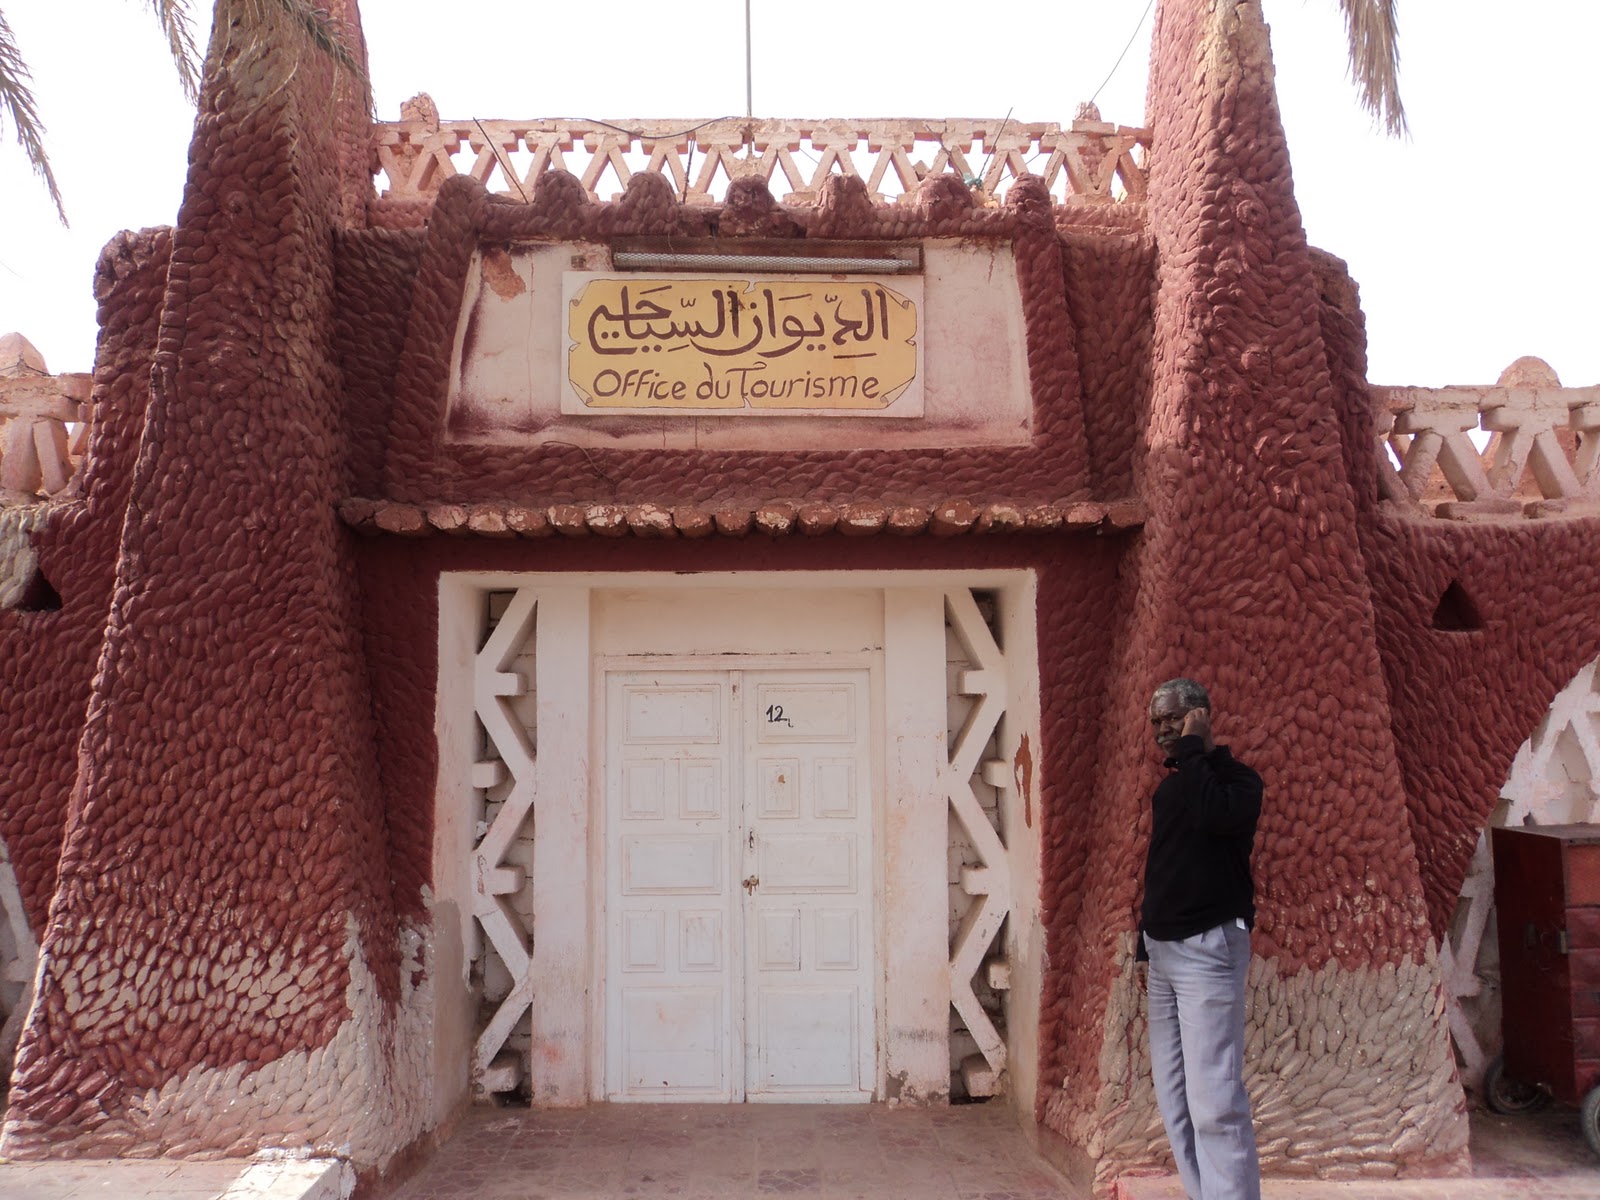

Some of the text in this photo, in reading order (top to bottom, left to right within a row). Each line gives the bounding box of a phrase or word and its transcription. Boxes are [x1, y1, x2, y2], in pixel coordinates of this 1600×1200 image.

[593, 361, 881, 400] Office du Tourisme
